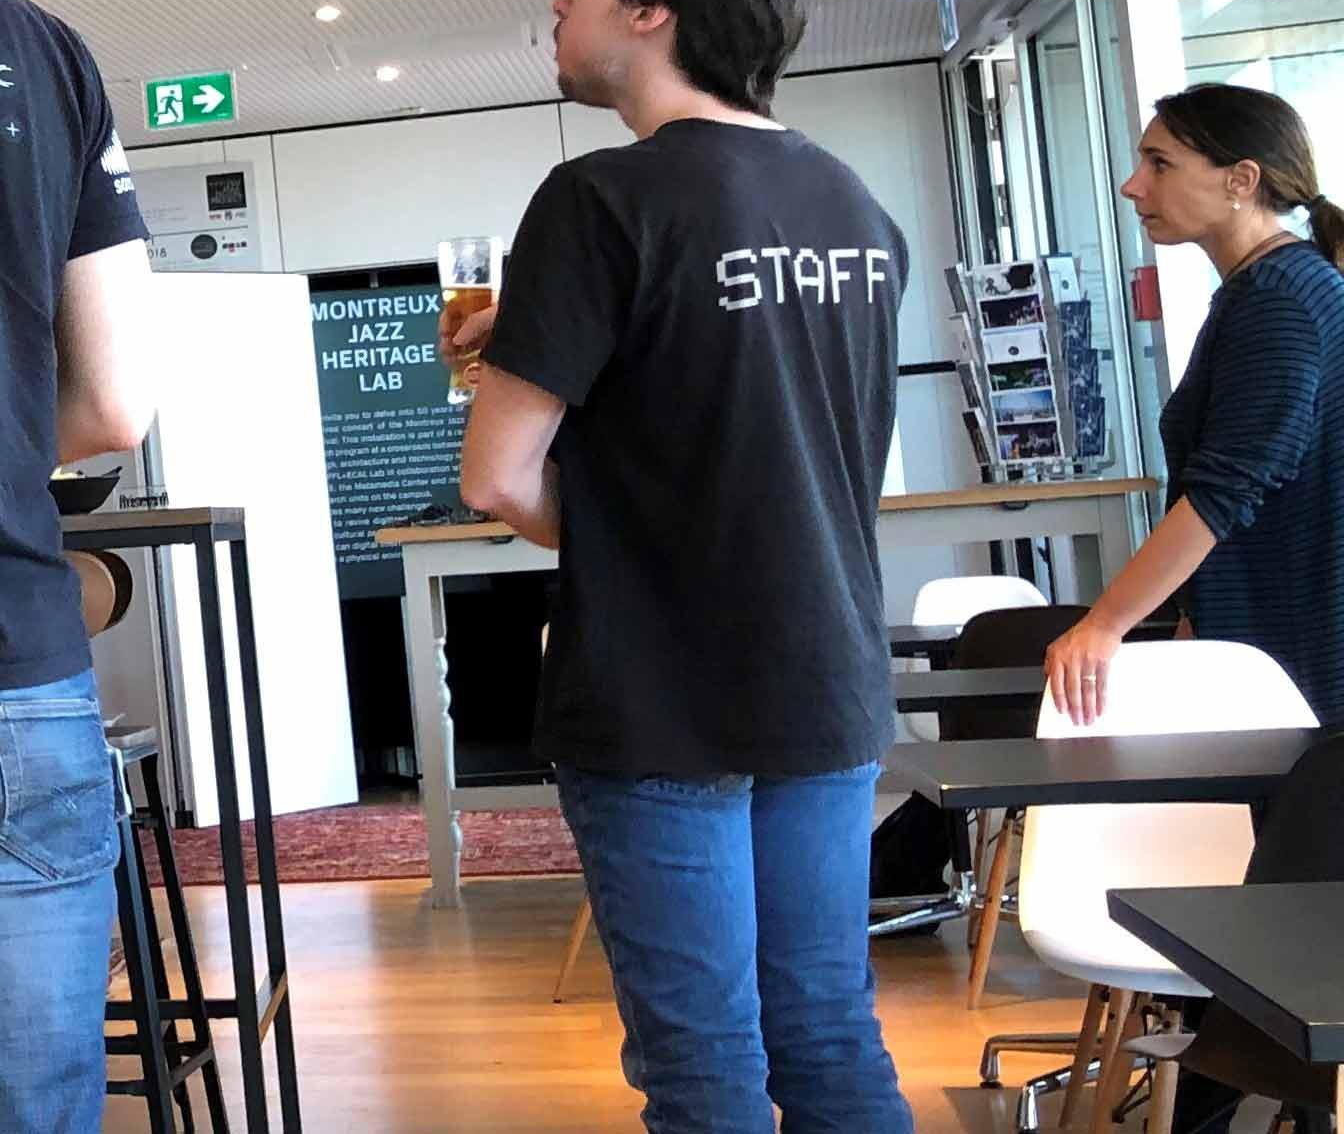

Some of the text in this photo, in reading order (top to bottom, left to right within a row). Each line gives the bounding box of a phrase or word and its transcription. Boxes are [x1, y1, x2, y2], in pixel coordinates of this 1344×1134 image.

[716, 247, 890, 311] STAFF
[311, 294, 440, 321] MONTREUX
[348, 321, 404, 344] JAZZ
[322, 344, 436, 370] HERITAGE
[359, 371, 403, 391] LAB
